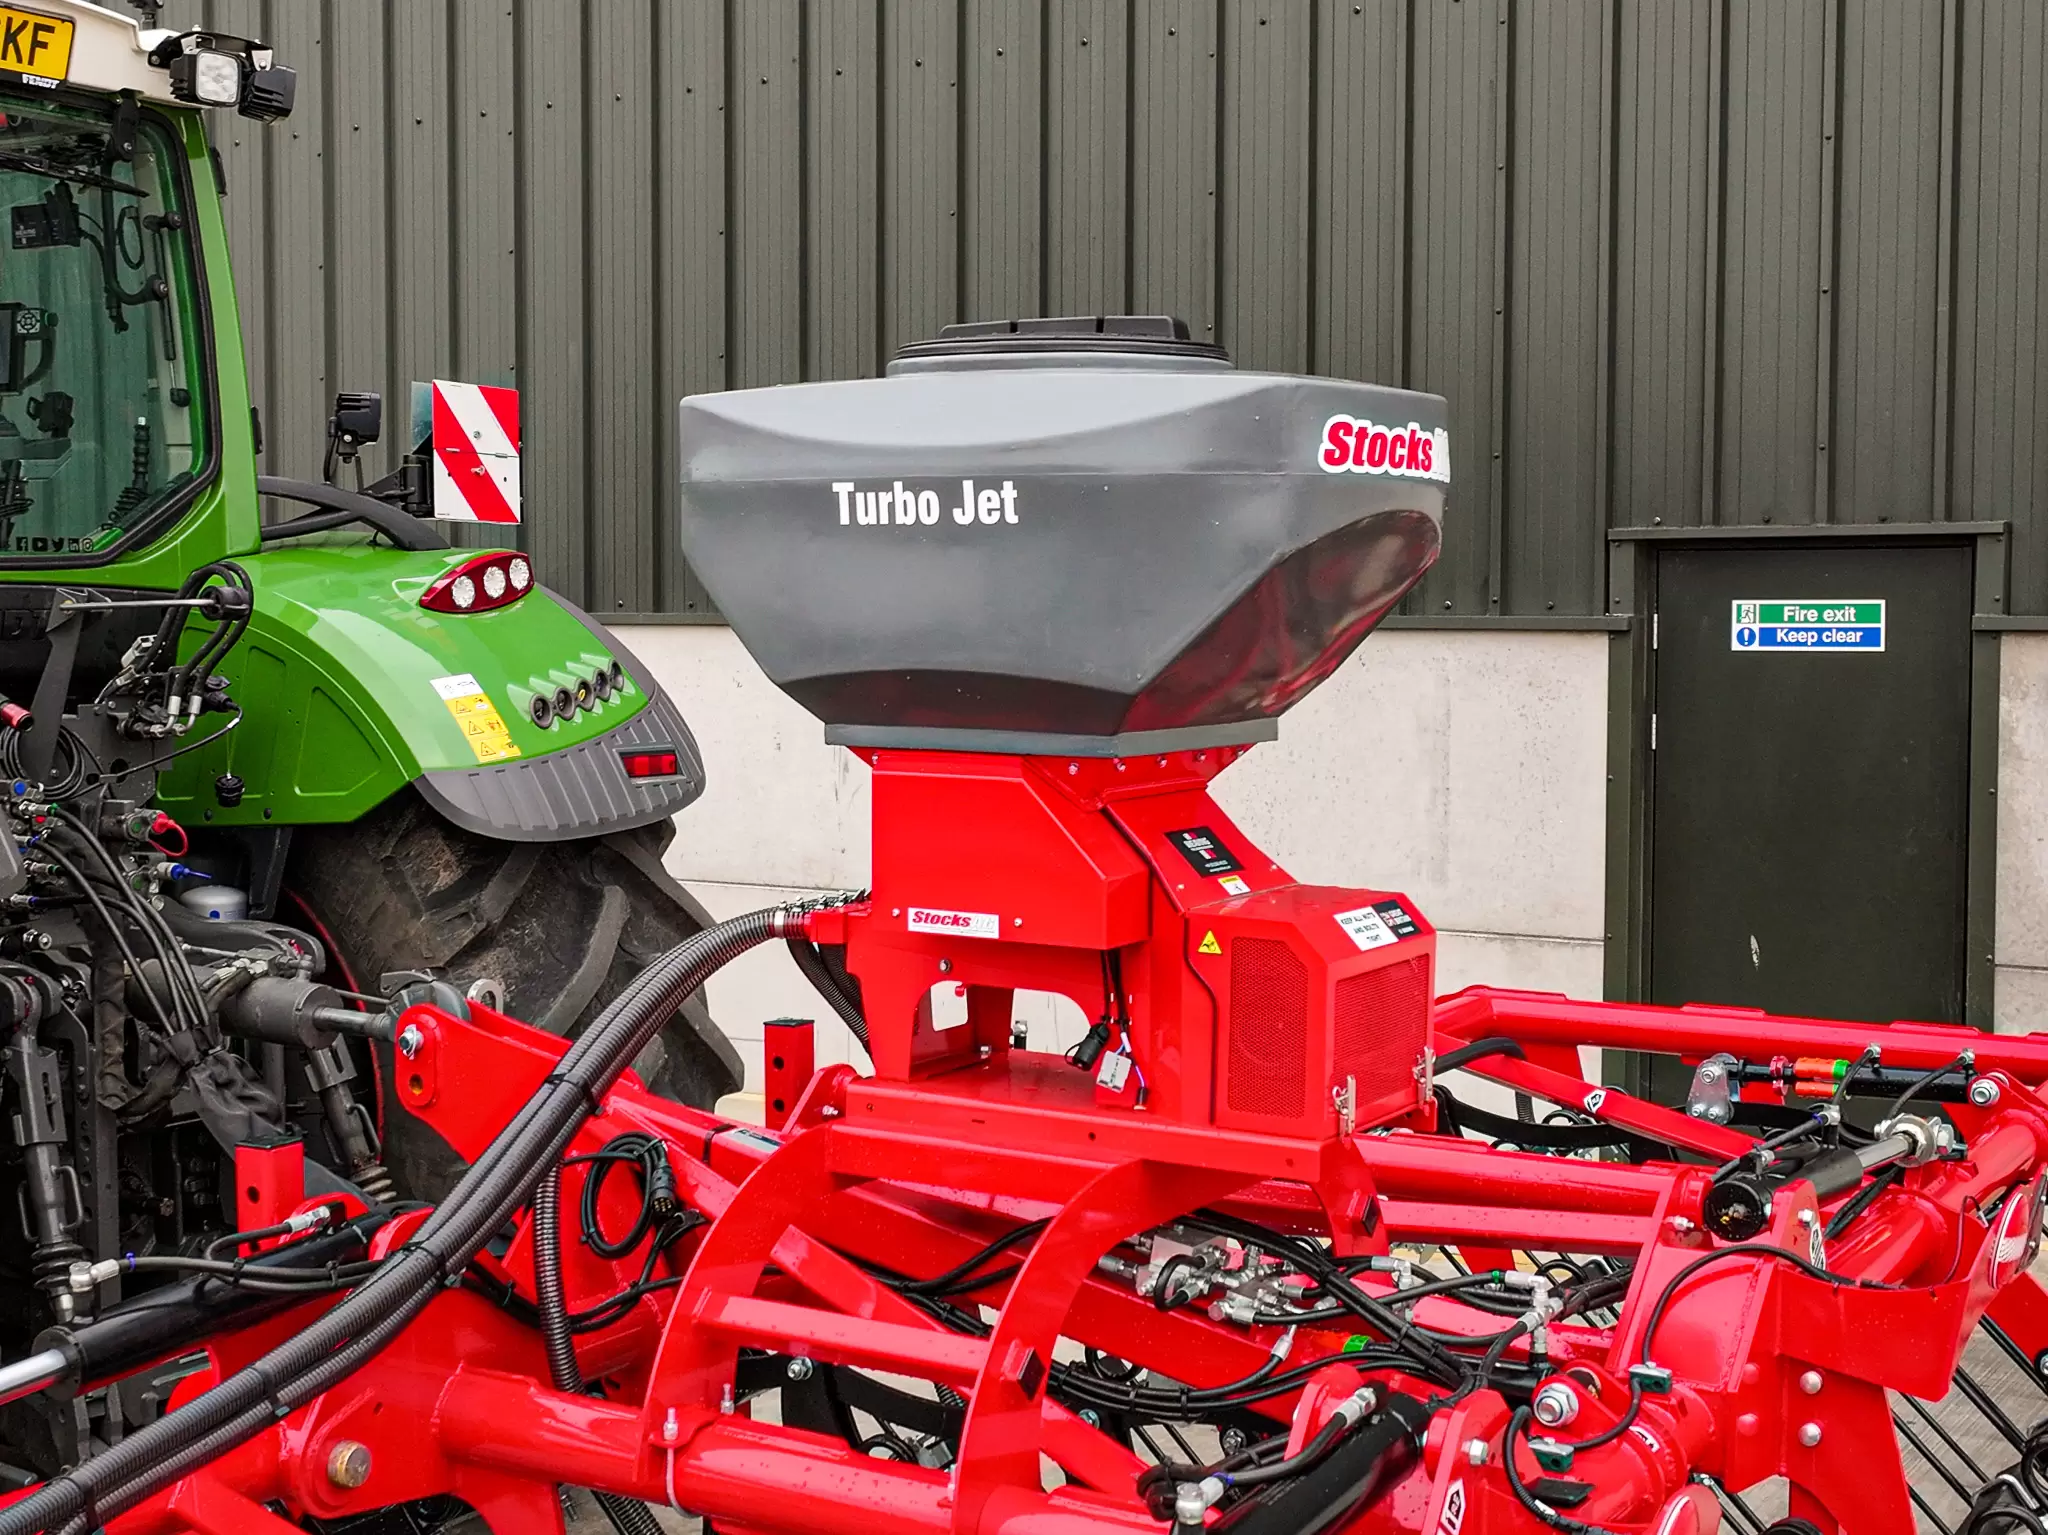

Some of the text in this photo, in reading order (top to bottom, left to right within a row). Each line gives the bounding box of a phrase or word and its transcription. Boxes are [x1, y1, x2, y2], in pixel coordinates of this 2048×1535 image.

[0, 15, 56, 67] KF
[1323, 421, 1433, 472] Stocks
[832, 479, 1019, 526] Turbo Jet
[1783, 606, 1856, 622] Fire exit
[1776, 628, 1863, 646] Keep clear
[912, 911, 971, 927] Stocks
